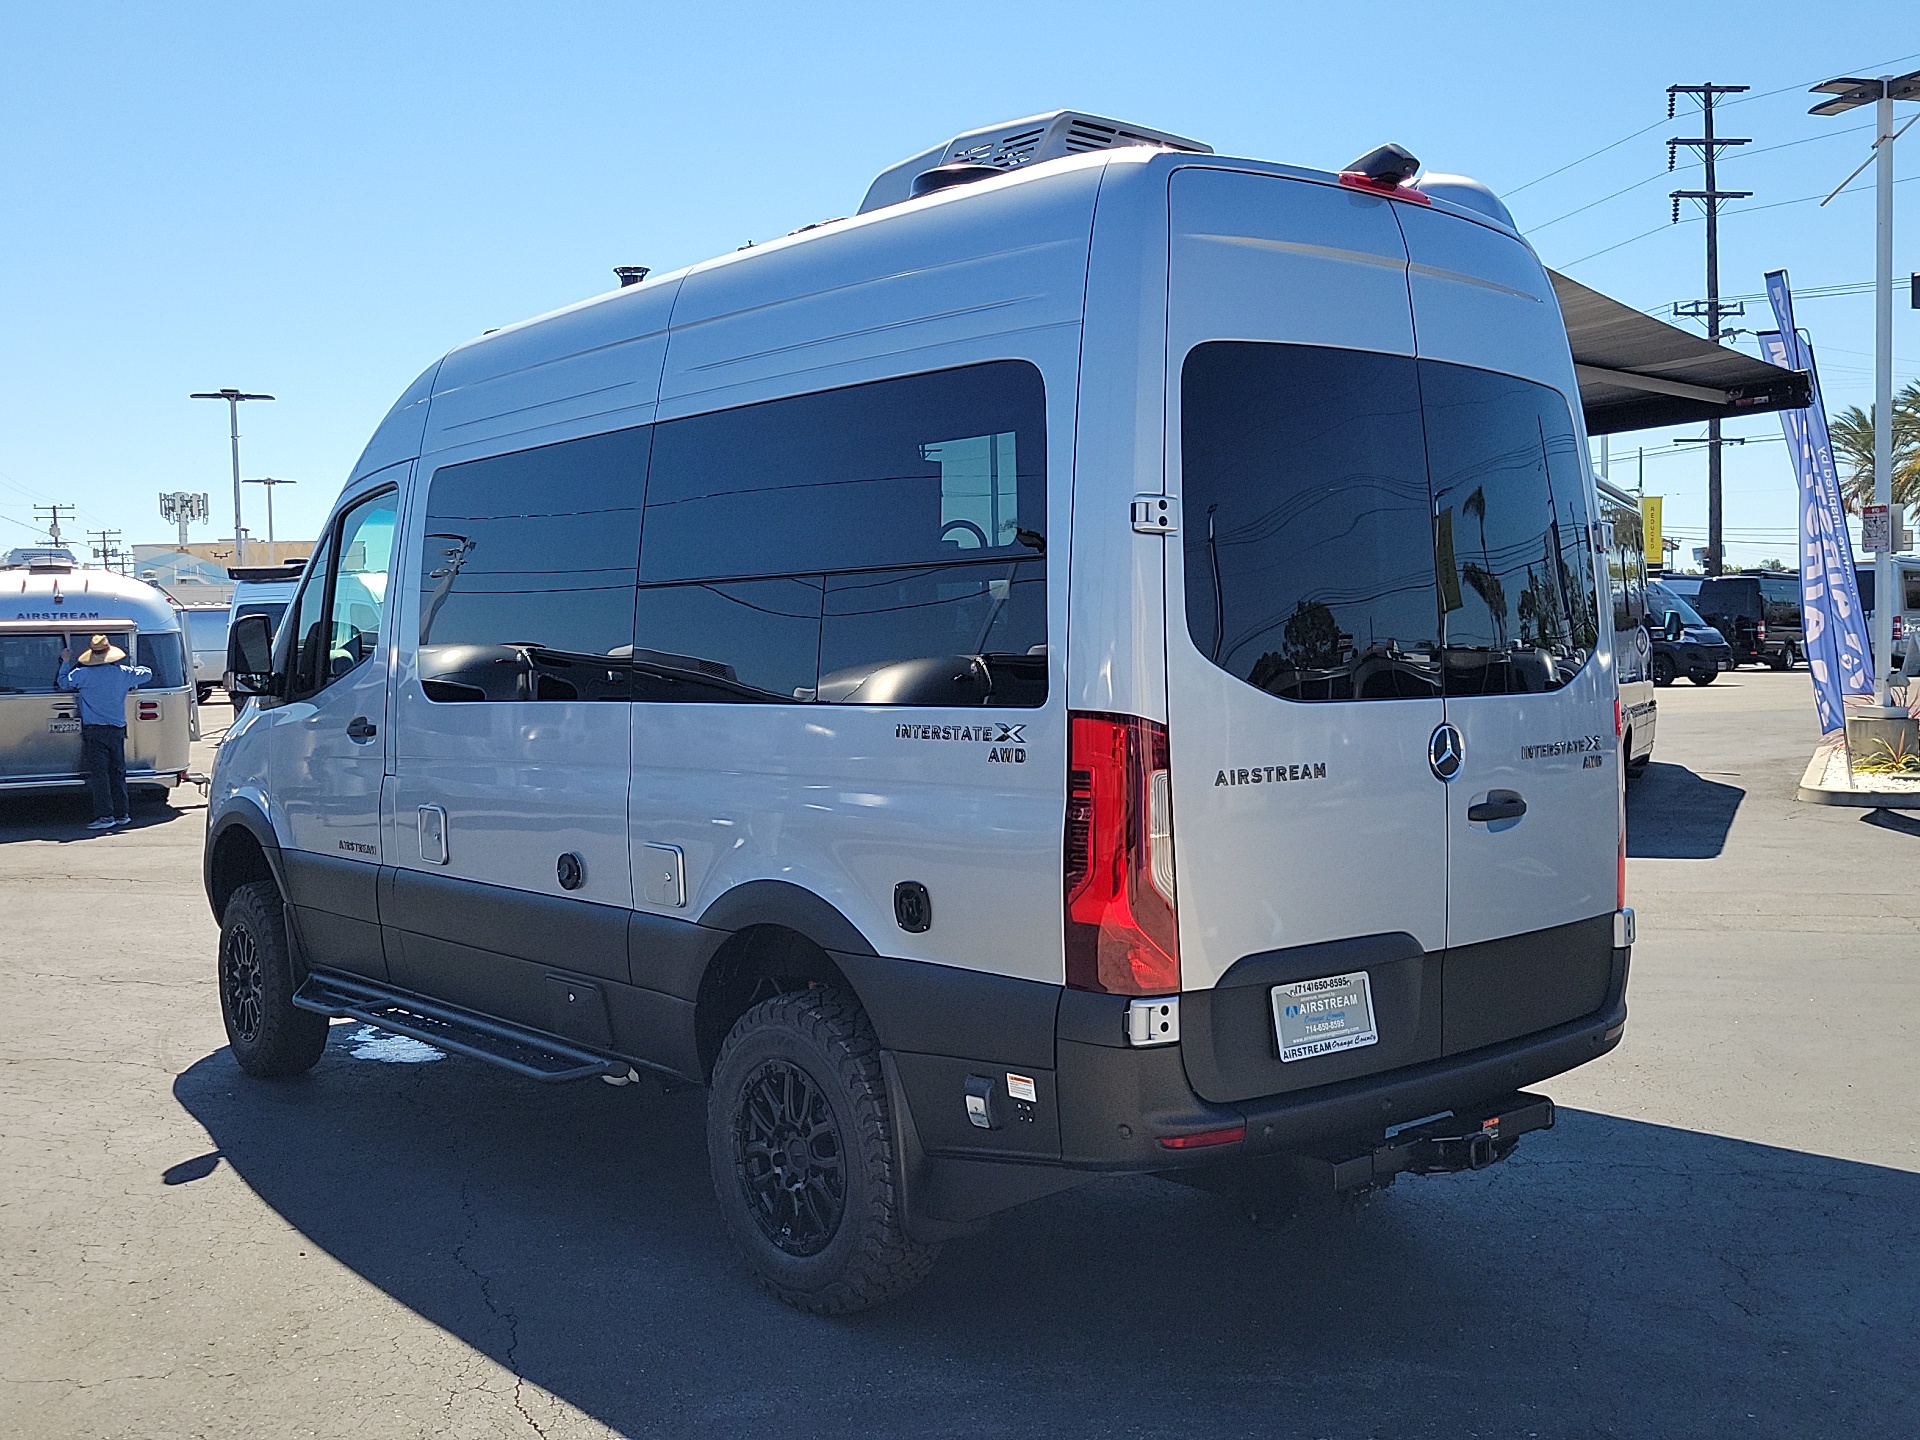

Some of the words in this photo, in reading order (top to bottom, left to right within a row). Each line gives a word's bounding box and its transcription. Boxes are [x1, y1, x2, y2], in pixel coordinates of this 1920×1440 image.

[16, 612, 99, 620] AIRSTREAM
[987, 747, 1027, 763] AWD
[1582, 755, 1603, 770] AWD
[1214, 763, 1327, 786] AIRSTREAM
[338, 839, 377, 856] AIRSTREAM
[1299, 994, 1358, 1014] AIRSTREAM
[1305, 1019, 1345, 1034] 714-650-8595
[1283, 1041, 1332, 1060] AIRSTREAM
[1332, 1040, 1354, 1049] Orange
[1354, 1034, 1377, 1045] County
